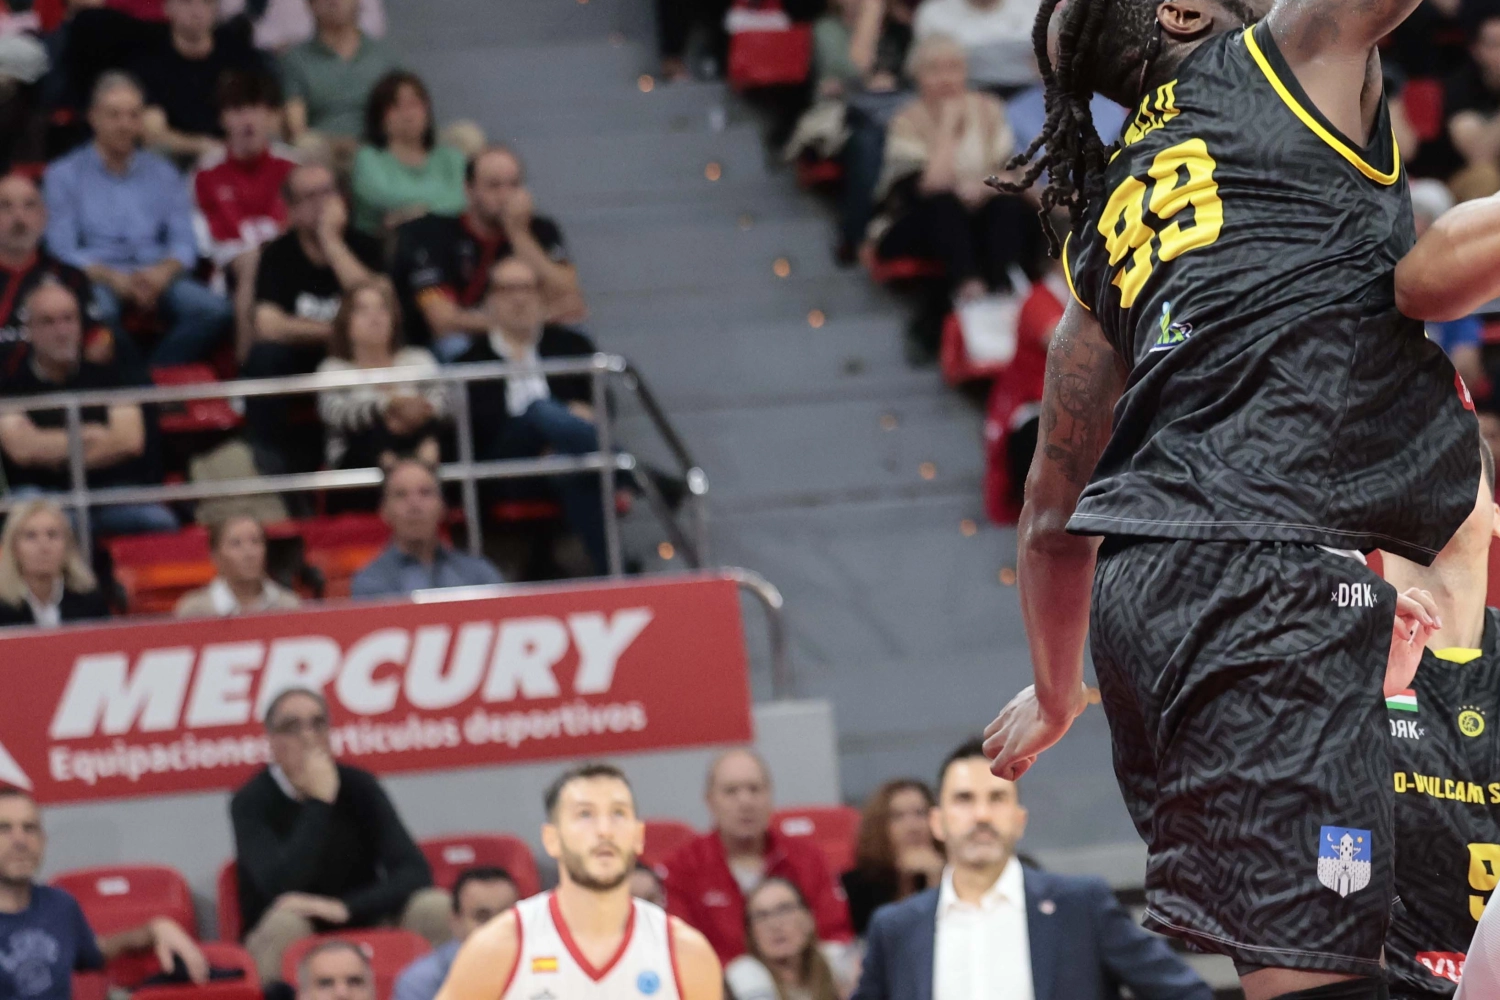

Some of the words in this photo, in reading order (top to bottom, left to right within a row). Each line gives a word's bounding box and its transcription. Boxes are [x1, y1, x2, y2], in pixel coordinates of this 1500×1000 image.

[1098, 138, 1223, 309] 99
[50, 606, 654, 741] MERCURY
[463, 697, 648, 748] deportivos
